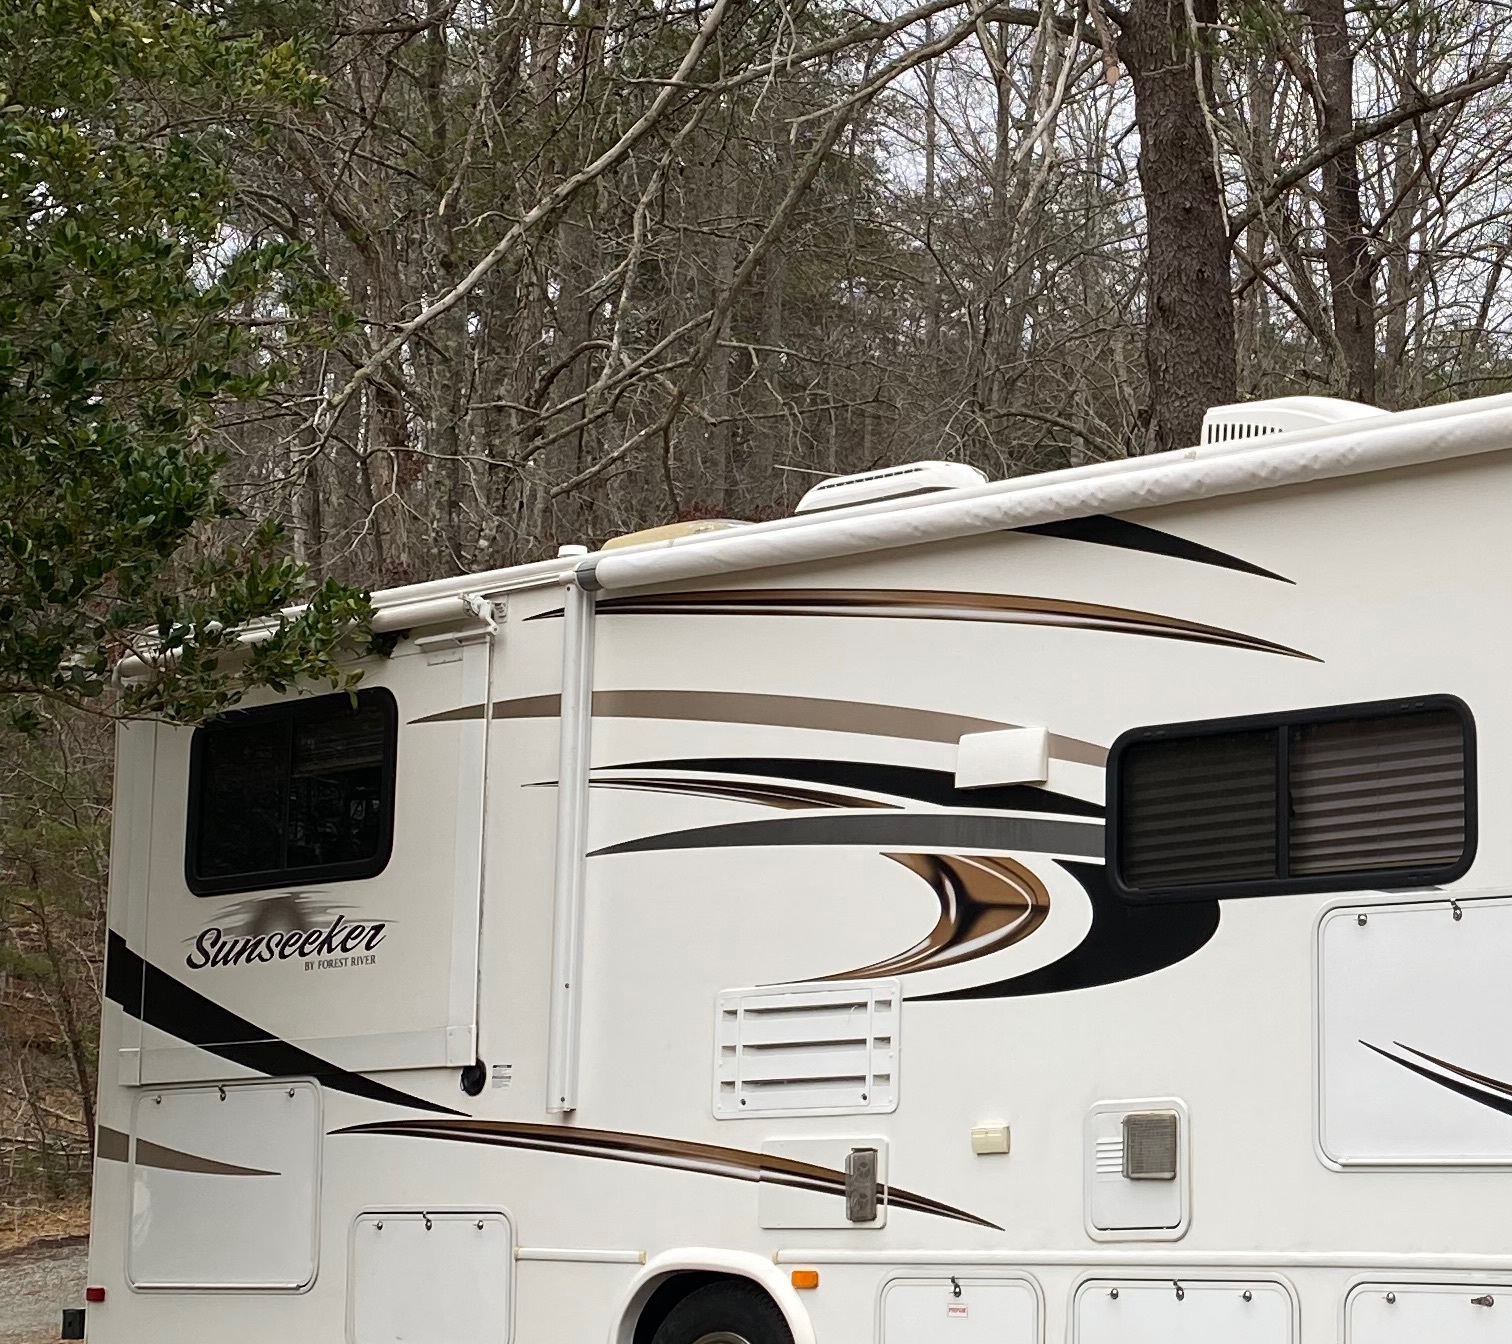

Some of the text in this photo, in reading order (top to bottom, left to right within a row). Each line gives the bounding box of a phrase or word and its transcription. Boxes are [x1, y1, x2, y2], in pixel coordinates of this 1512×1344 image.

[186, 914, 387, 969] Sunseeker
[304, 954, 376, 971] BY FOREST RIVER
